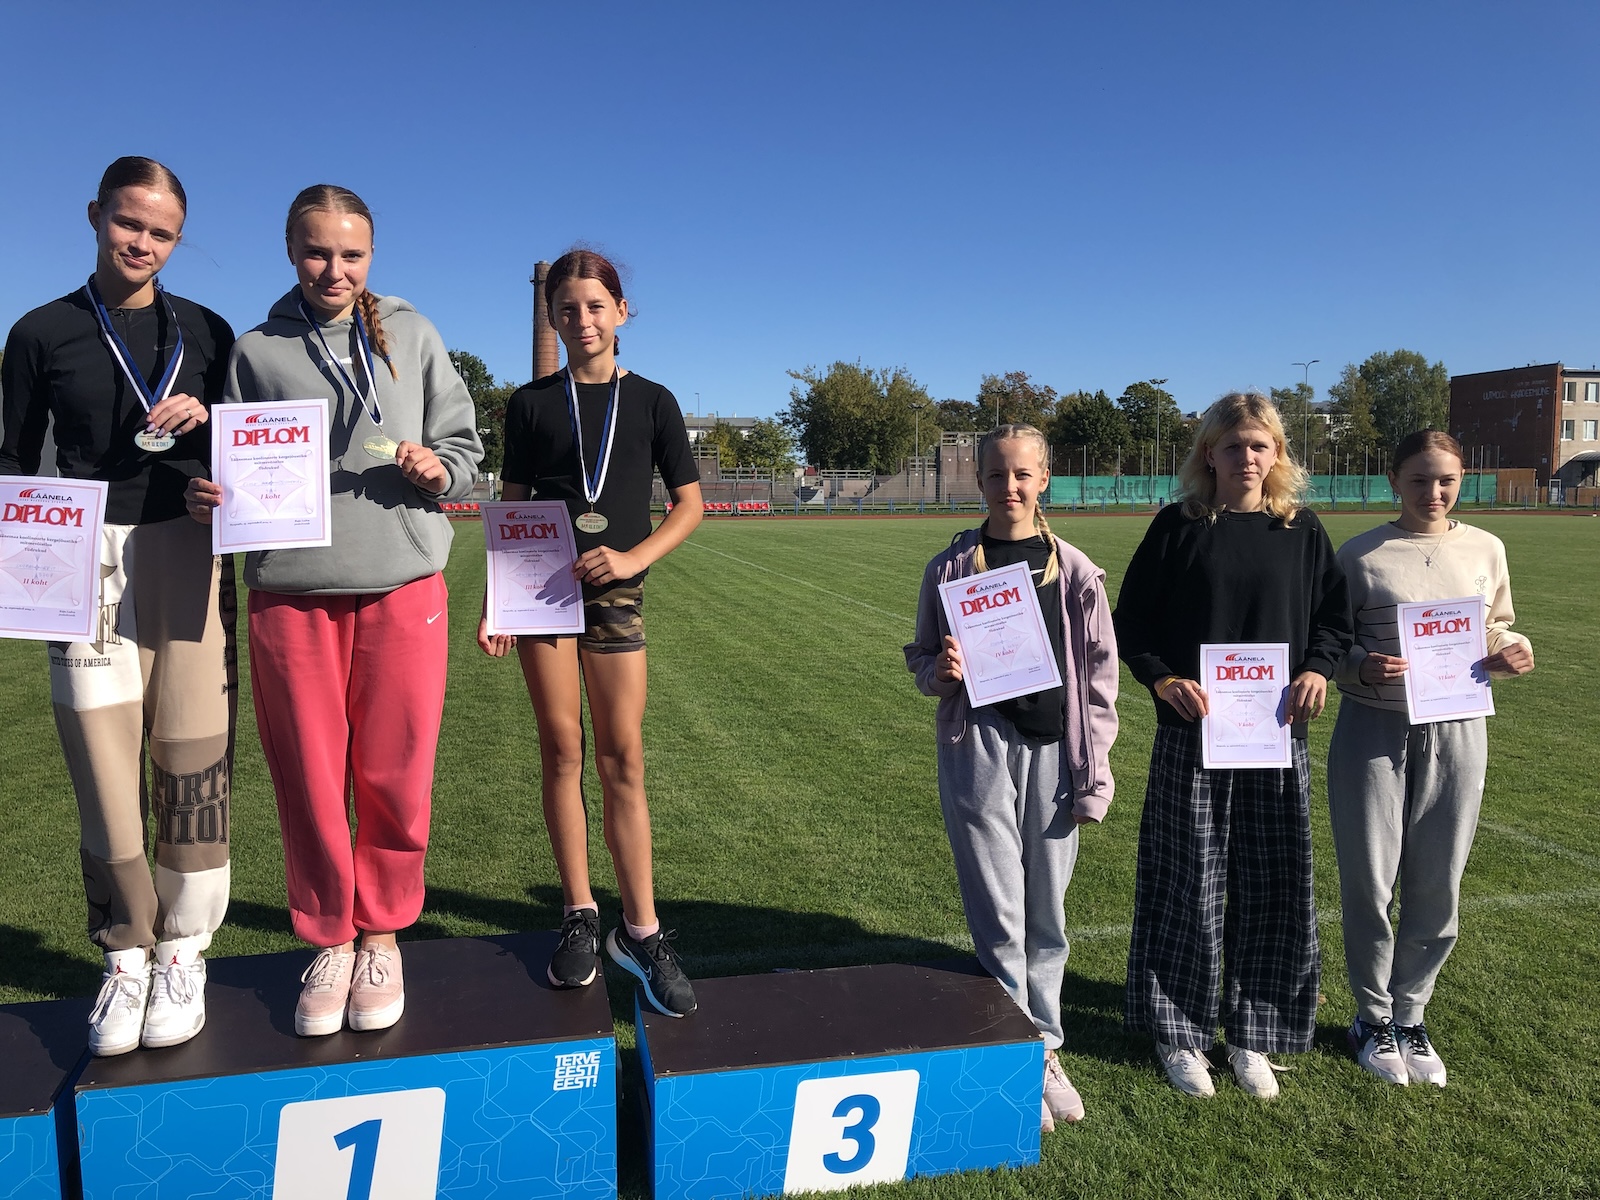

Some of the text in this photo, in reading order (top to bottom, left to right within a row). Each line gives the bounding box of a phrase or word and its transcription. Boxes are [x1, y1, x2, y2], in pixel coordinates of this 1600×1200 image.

[232, 426, 310, 447] DIPLOM
[1, 503, 85, 527] DIPLOM
[499, 523, 560, 540] DIPLOM
[31, 578, 48, 587] koht
[959, 586, 1022, 617] DIPLOM
[1413, 617, 1471, 637] DIPLOM
[75, 658, 81, 667] OF
[83, 657, 111, 667] AMERICA
[1216, 665, 1275, 681] DIPLOM
[555, 1051, 601, 1068] TERVE
[555, 1063, 599, 1079] EESTI
[822, 1094, 881, 1174] 3
[333, 1118, 382, 1200] 1
